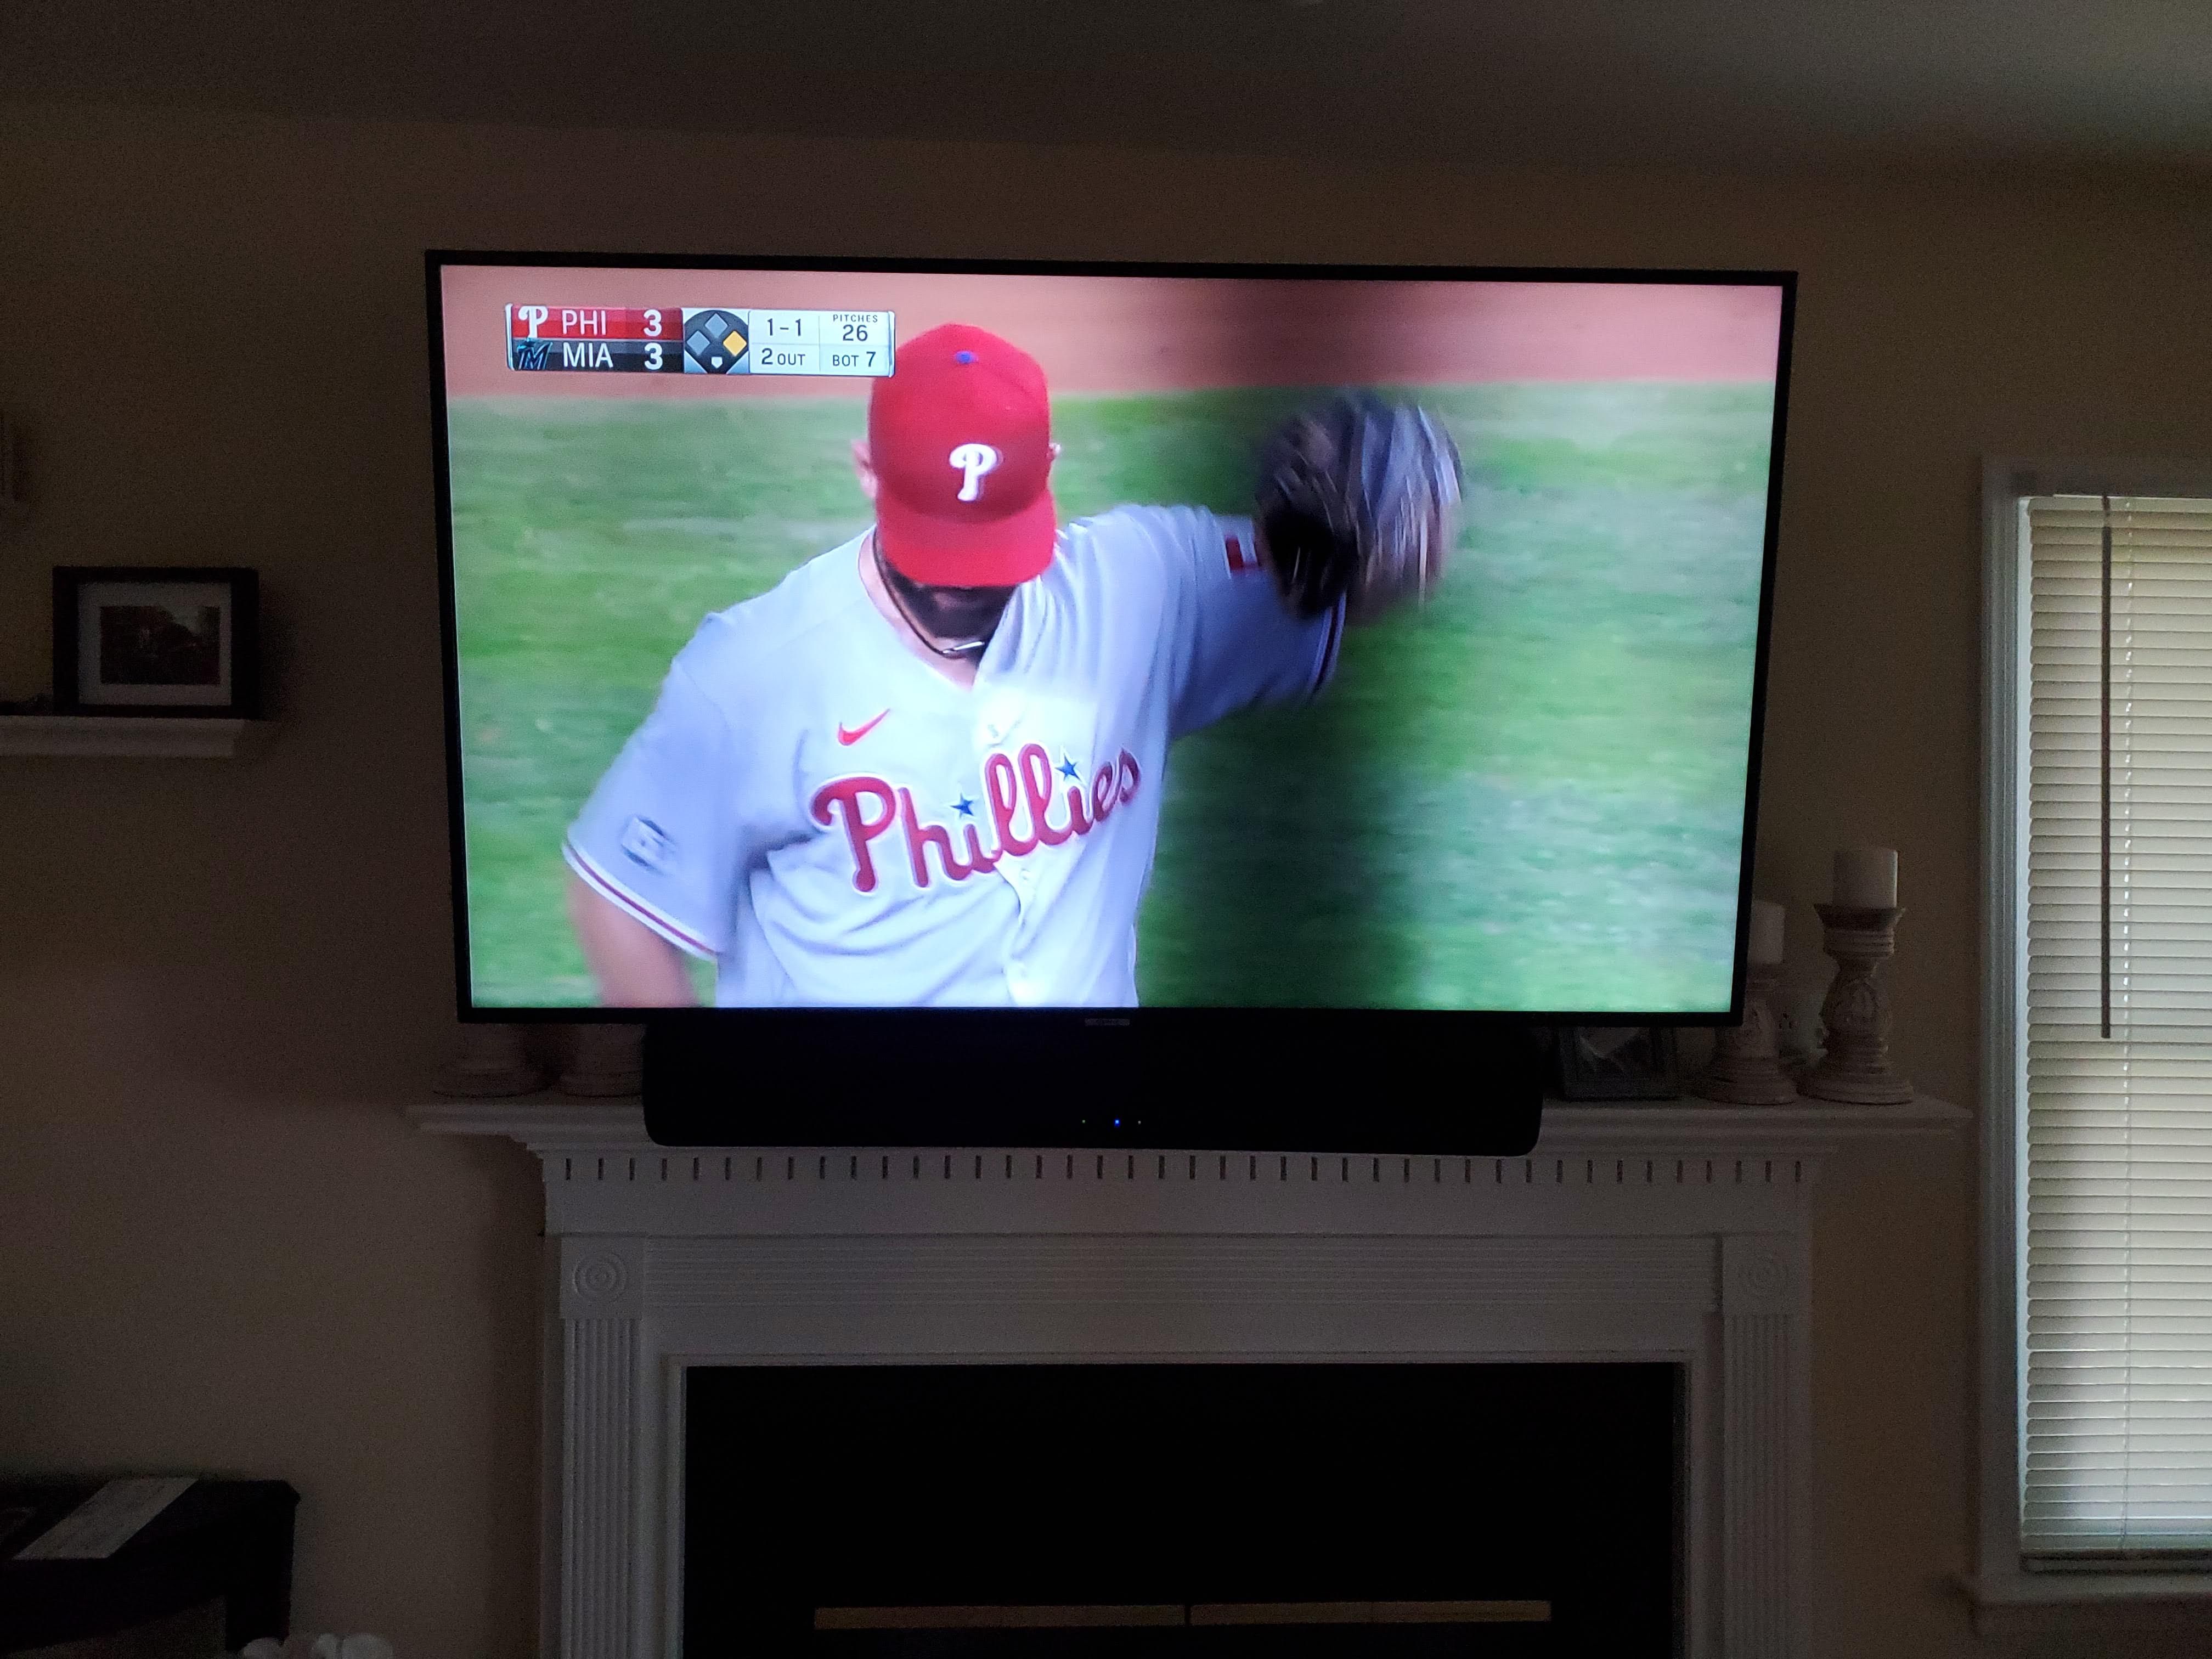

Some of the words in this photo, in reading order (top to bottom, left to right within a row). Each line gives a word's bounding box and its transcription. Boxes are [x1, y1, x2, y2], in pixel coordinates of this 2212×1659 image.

[562, 310, 607, 335] PHI
[643, 309, 662, 337] 3
[833, 314, 878, 323] PITCHES
[843, 324, 868, 341] 26
[563, 342, 613, 368] MIA
[644, 342, 663, 370] 3
[761, 348, 774, 365] 2
[777, 353, 805, 366] OUT
[832, 355, 859, 367] BOT
[866, 351, 876, 368] 7
[949, 443, 997, 501] P
[810, 743, 1141, 893] Phillies
